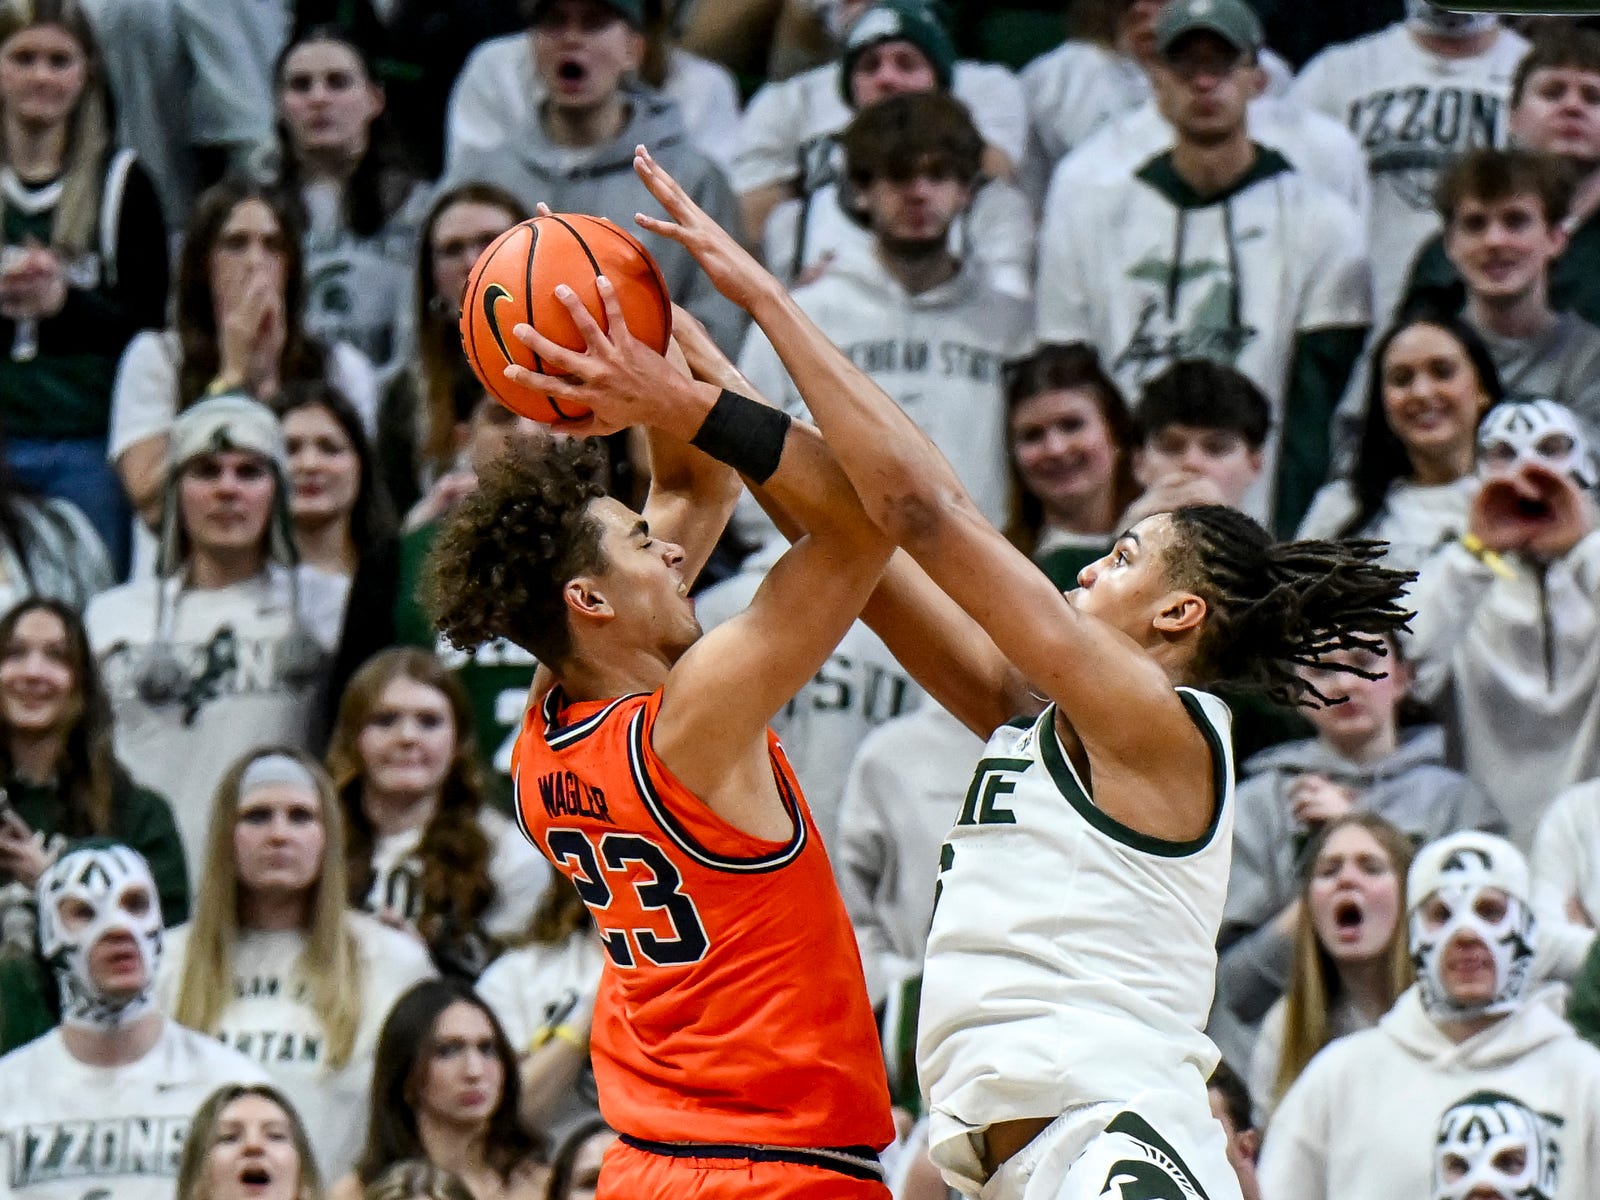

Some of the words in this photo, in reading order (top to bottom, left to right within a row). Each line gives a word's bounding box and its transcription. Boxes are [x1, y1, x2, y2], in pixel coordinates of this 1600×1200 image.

[1349, 84, 1500, 148] IZZON
[537, 771, 616, 825] WAGLER
[545, 827, 712, 970] 23
